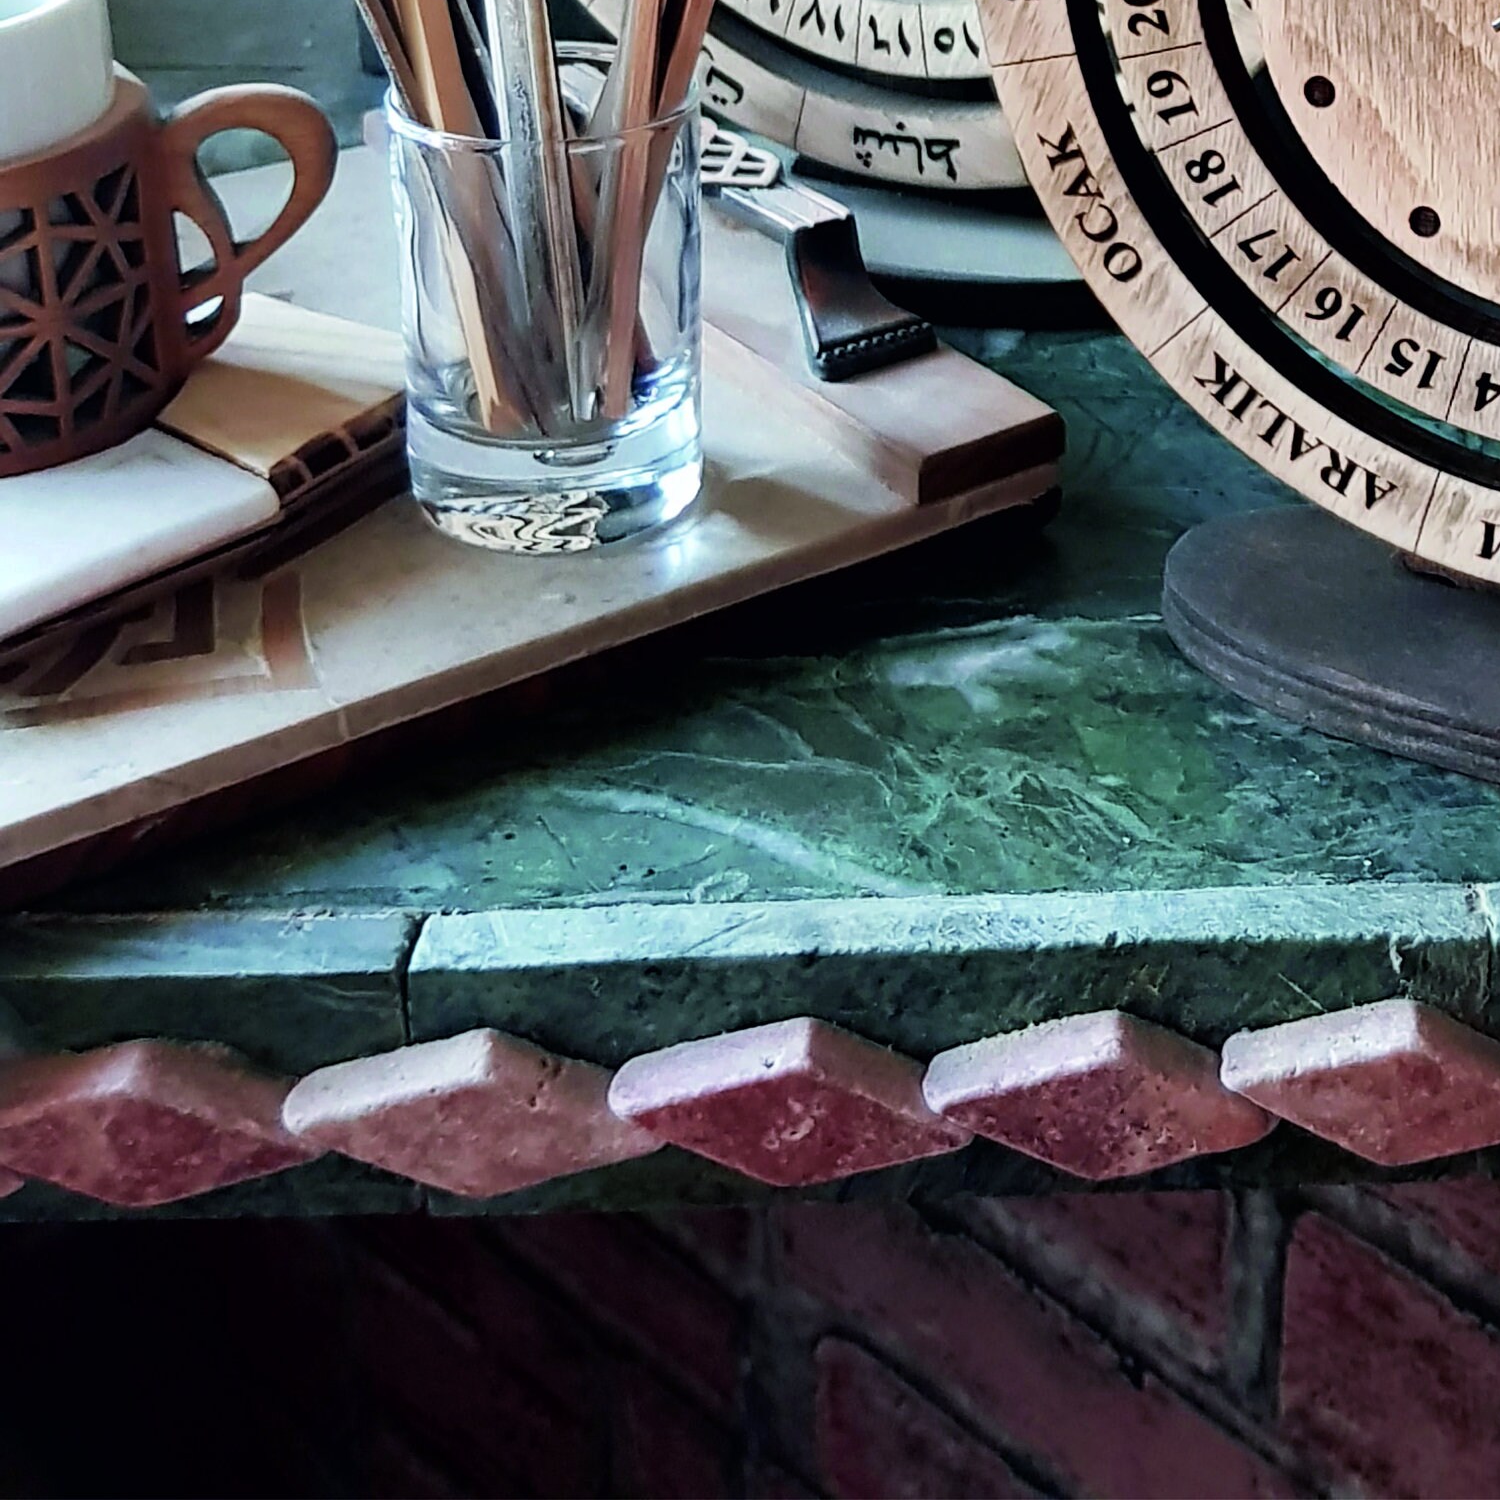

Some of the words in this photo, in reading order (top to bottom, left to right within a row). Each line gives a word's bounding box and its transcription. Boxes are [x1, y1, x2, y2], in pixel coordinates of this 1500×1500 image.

[1146, 68, 1200, 127] 19
[852, 121, 961, 183] شباط
[1185, 148, 1244, 208] 18
[1036, 120, 1143, 284] OCAK
[1235, 228, 1302, 283] 17
[1304, 286, 1368, 343] 16
[1383, 337, 1447, 391] 15
[1192, 350, 1400, 511] ARALIK
